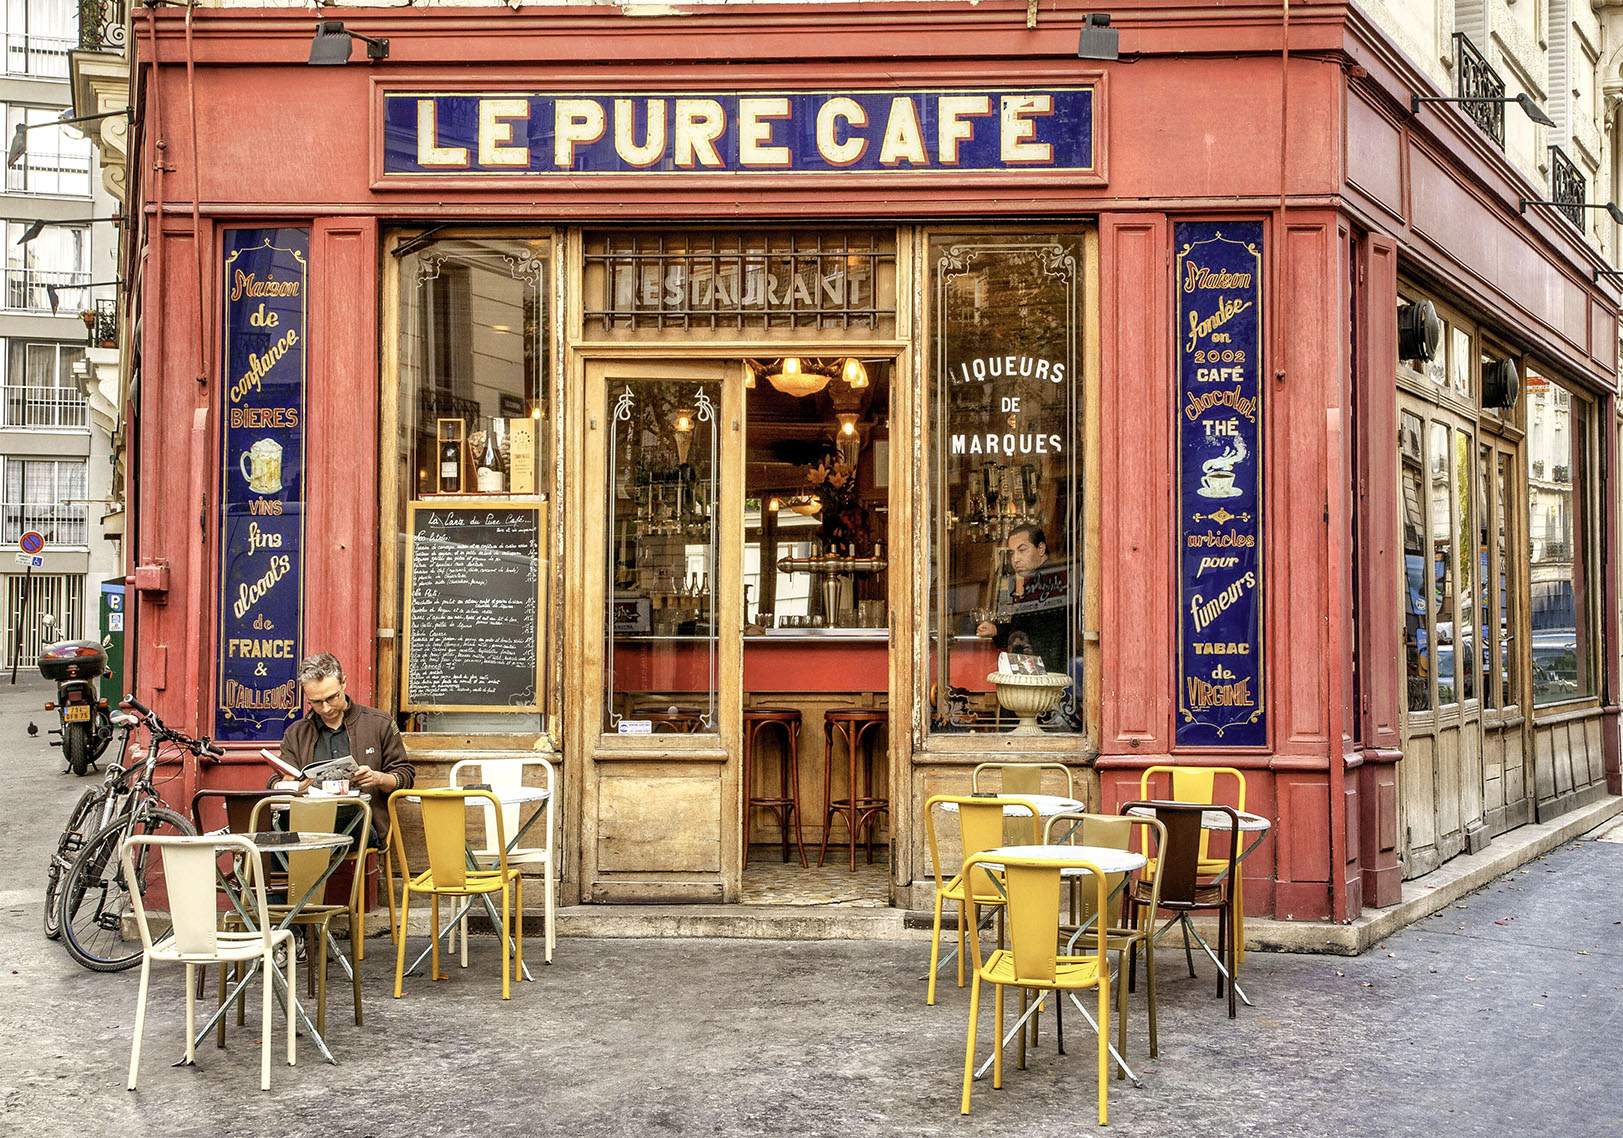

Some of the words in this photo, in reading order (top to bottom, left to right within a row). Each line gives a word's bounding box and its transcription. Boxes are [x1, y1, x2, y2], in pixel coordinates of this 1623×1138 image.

[417, 99, 530, 167] LE
[554, 98, 792, 168] PURE
[231, 269, 299, 301] Maison
[1184, 260, 1251, 292] Maison
[250, 303, 279, 327] de
[1186, 296, 1252, 353] fondée
[1211, 332, 1231, 343] en
[231, 329, 299, 403] confiance
[1194, 350, 1245, 363] 2002
[1197, 366, 1244, 382] CAFÉ
[1001, 397, 1020, 413] DE
[1185, 385, 1257, 424] chocolat
[1202, 418, 1239, 436] THÉ
[951, 433, 1062, 457] MARQUES
[470, 515, 481, 525] du
[248, 522, 282, 556] fins
[1187, 529, 1254, 548] articles
[1197, 556, 1239, 579] pour
[233, 555, 291, 619] alcools
[110, 594, 121, 609] P
[1190, 571, 1255, 633] fumeurs
[253, 614, 274, 630] de
[229, 639, 294, 658] FRANCE
[1193, 642, 1249, 654] TABAC
[254, 662, 267, 676] &
[1211, 664, 1236, 679] de
[226, 679, 295, 709] D'AILLEURS
[1187, 676, 1254, 707] VIRGINIE
